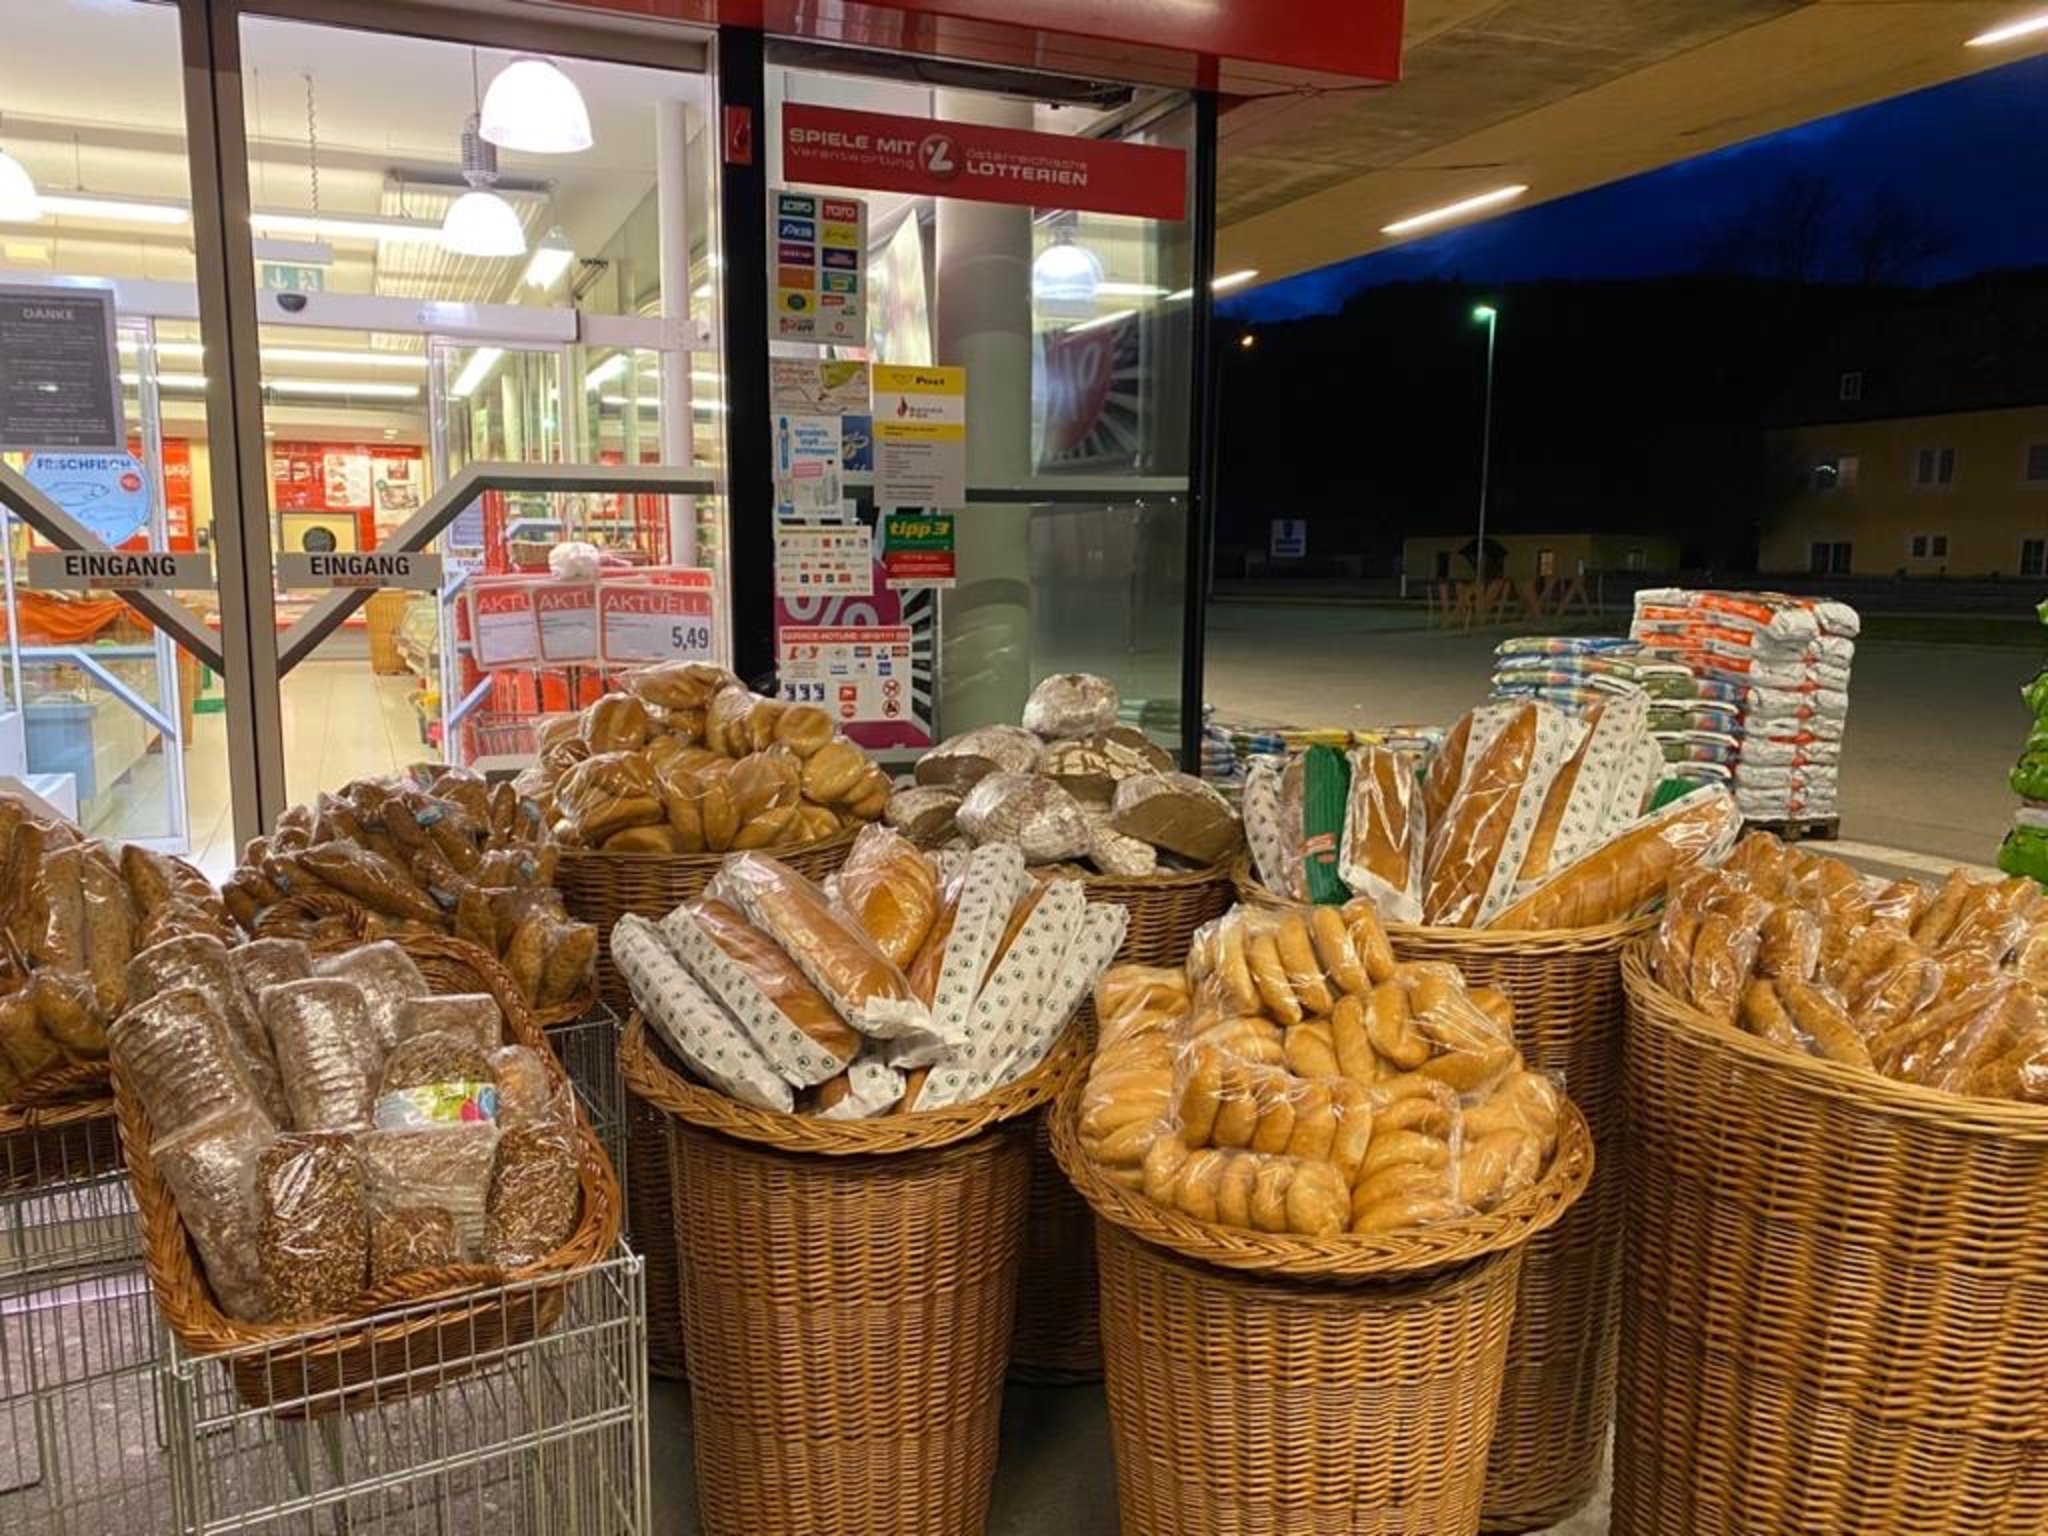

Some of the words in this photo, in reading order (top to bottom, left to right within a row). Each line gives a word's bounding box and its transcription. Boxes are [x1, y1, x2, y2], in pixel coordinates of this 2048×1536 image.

[789, 127, 869, 149] SPIELE
[877, 138, 916, 155] MIT
[789, 145, 915, 170] Verantwortung
[966, 160, 1088, 186] LOTTERIEN
[22, 307, 75, 321] DANKE
[37, 457, 131, 471] FRISCHFISCH
[65, 555, 176, 576] EINGANG
[310, 556, 409, 576] EINGANG
[672, 625, 709, 650] 5,49
